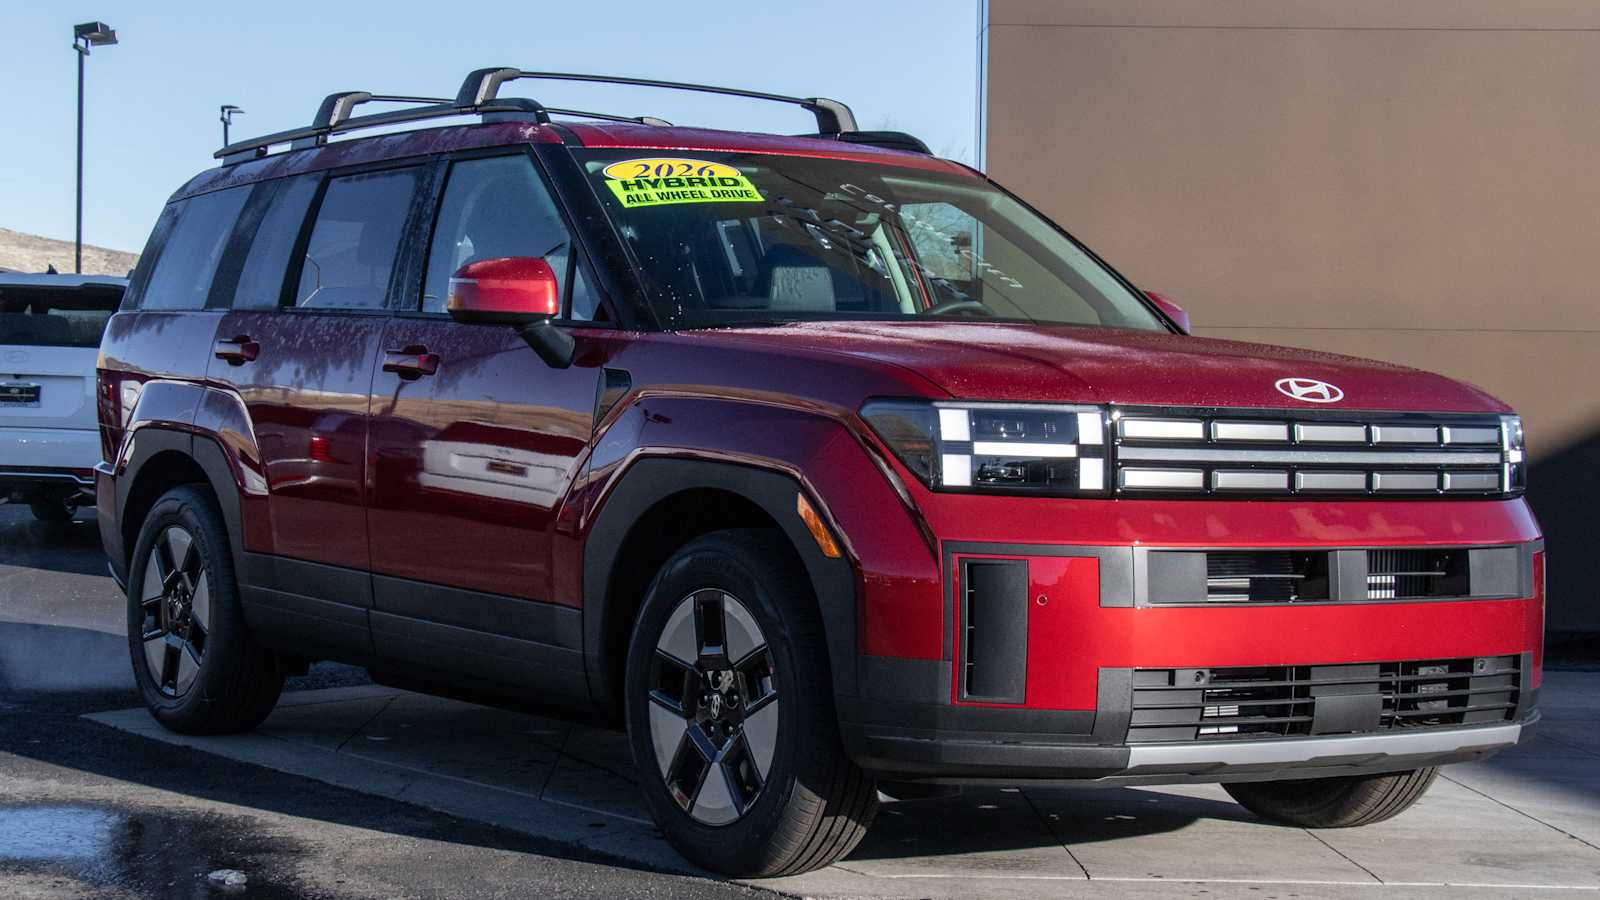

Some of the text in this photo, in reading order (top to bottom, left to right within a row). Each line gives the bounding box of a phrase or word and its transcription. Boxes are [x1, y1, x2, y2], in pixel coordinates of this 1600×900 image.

[634, 163, 714, 177] 2026
[620, 176, 741, 191] HYBRID
[625, 189, 755, 204] ALL WHEEL DRIVE
